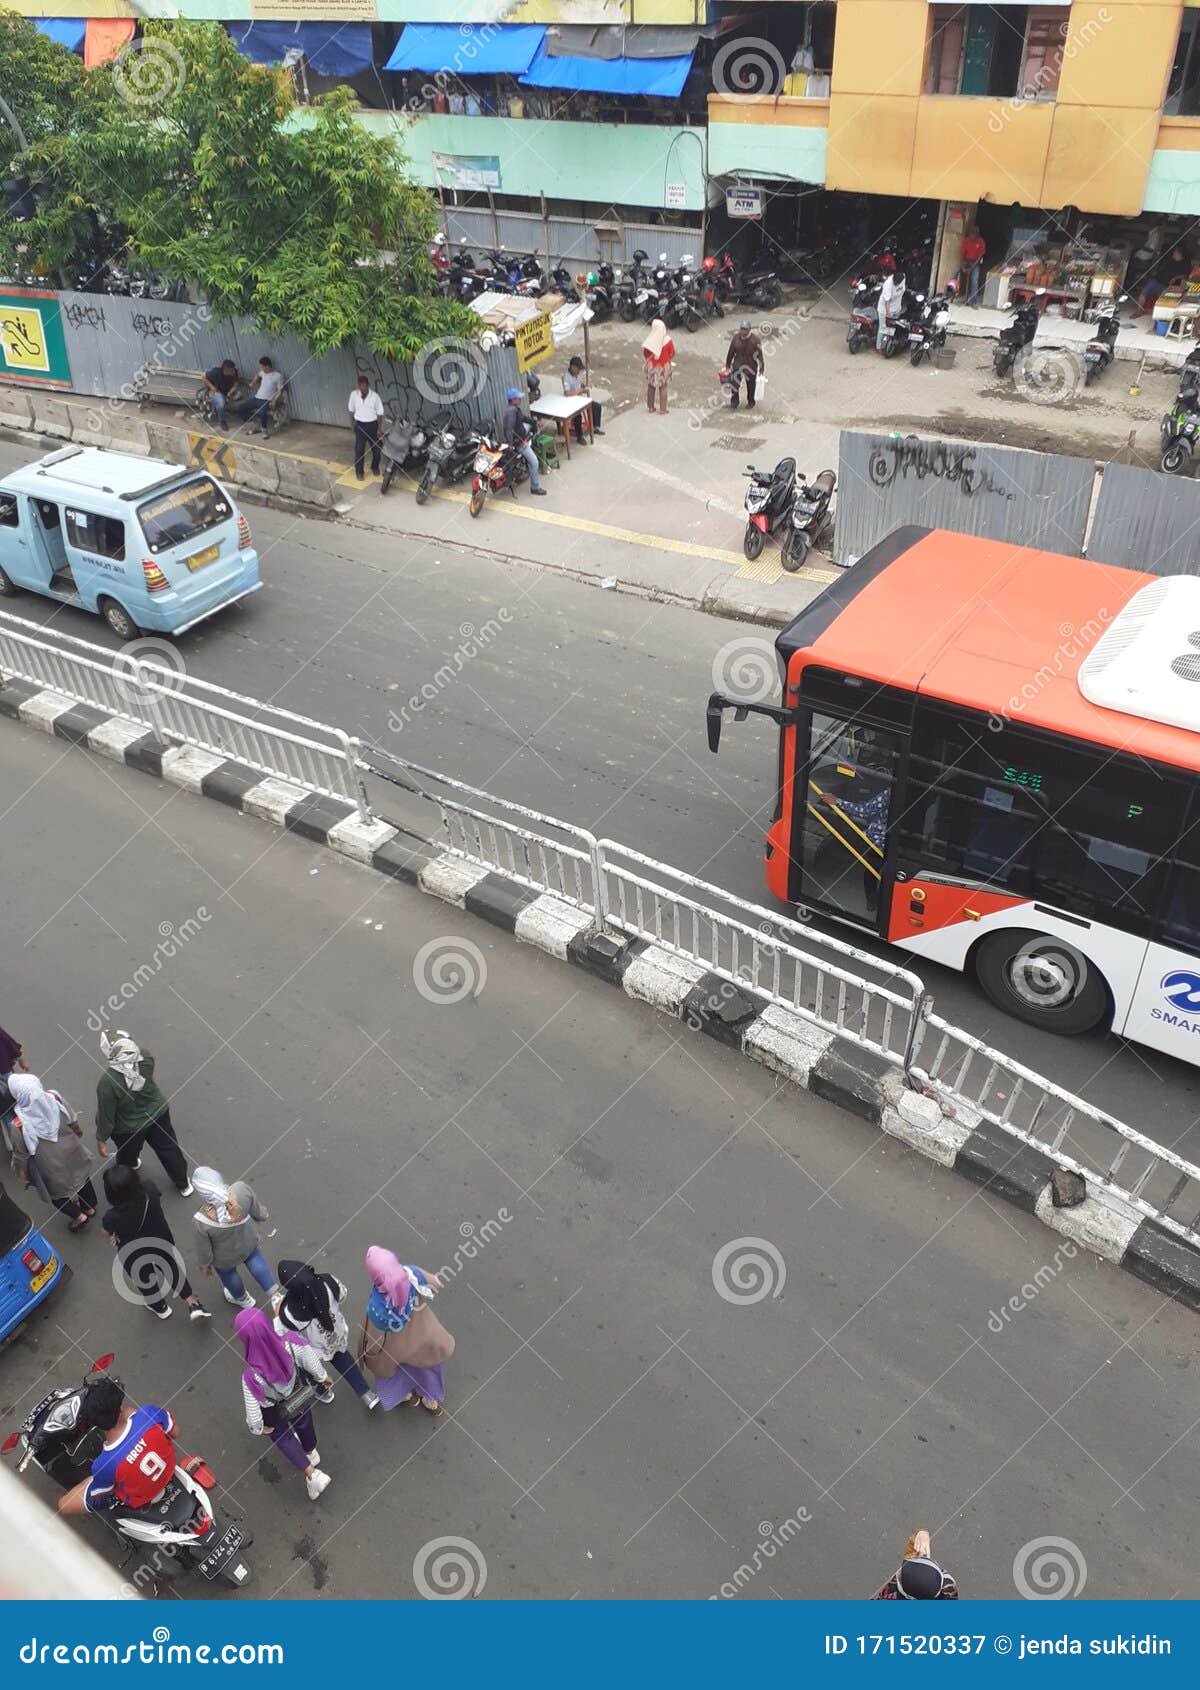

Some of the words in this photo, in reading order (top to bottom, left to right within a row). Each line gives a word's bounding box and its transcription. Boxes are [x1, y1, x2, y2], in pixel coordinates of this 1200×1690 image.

[734, 200, 754, 209] ATM
[523, 329, 544, 352] MOTOR
[140, 1451, 167, 1482] 9
[201, 1563, 209, 1572] B
[208, 1545, 225, 1565] 6124
